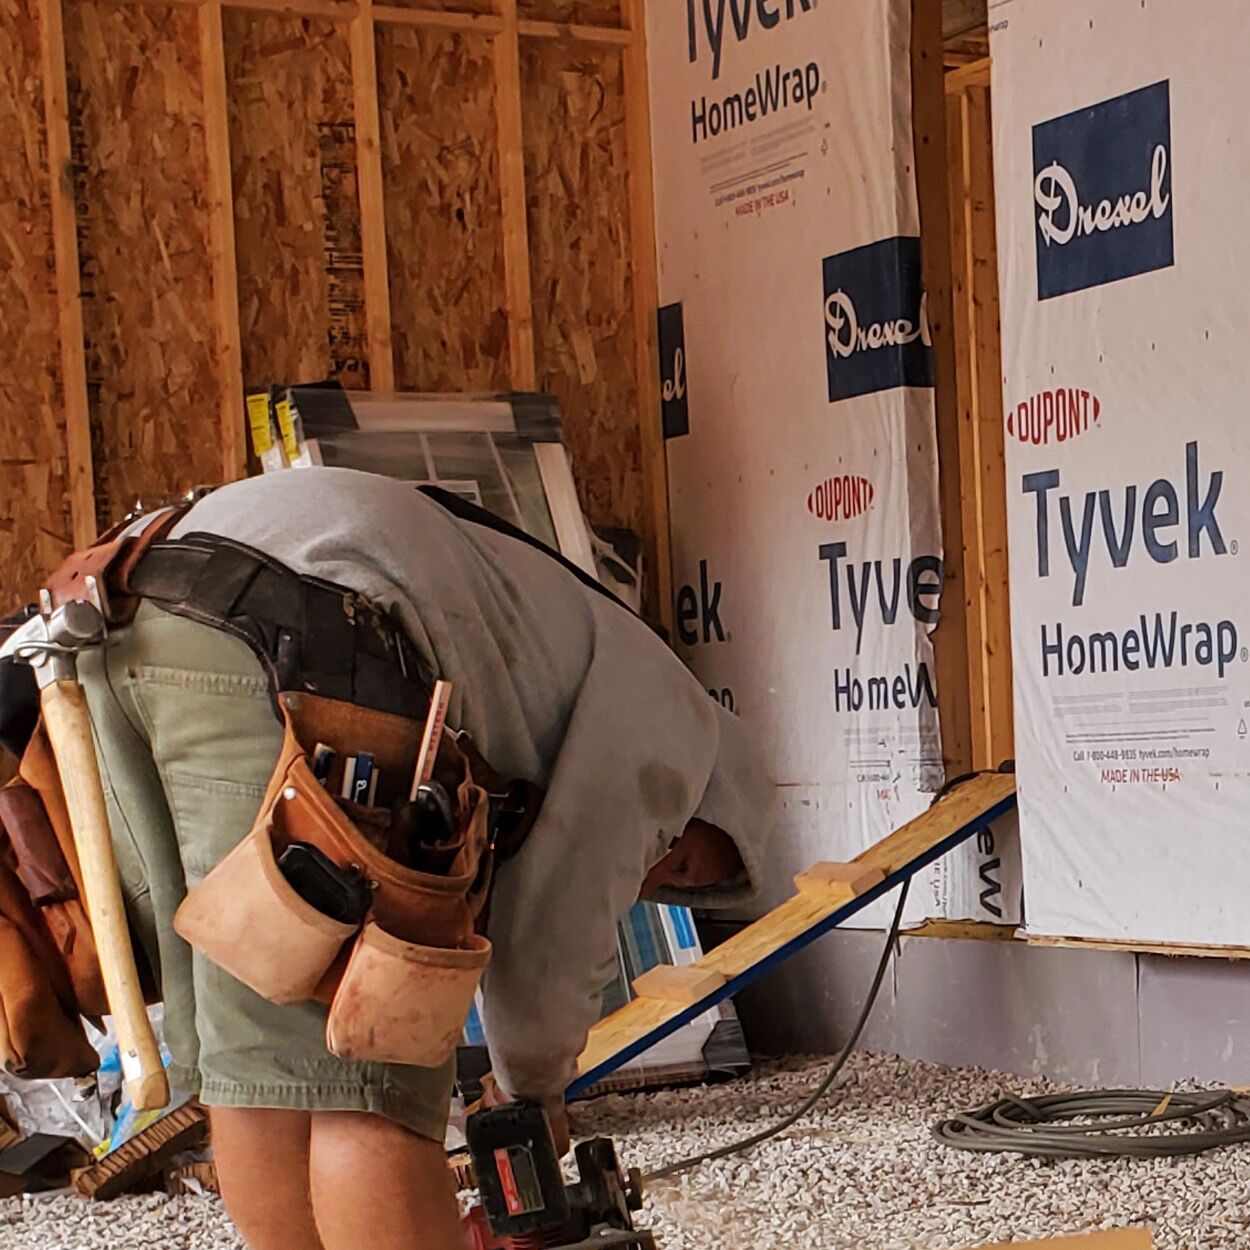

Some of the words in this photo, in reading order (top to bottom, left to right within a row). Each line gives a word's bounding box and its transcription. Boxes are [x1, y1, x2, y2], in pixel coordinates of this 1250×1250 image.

[1034, 145, 1169, 246] Drexel
[1018, 389, 1091, 443] DUPONT
[816, 475, 867, 521] DUPONT
[1101, 769, 1128, 784] MADE
[1130, 769, 1140, 783] IN
[1141, 768, 1160, 782] THE
[1162, 767, 1181, 782] USA
